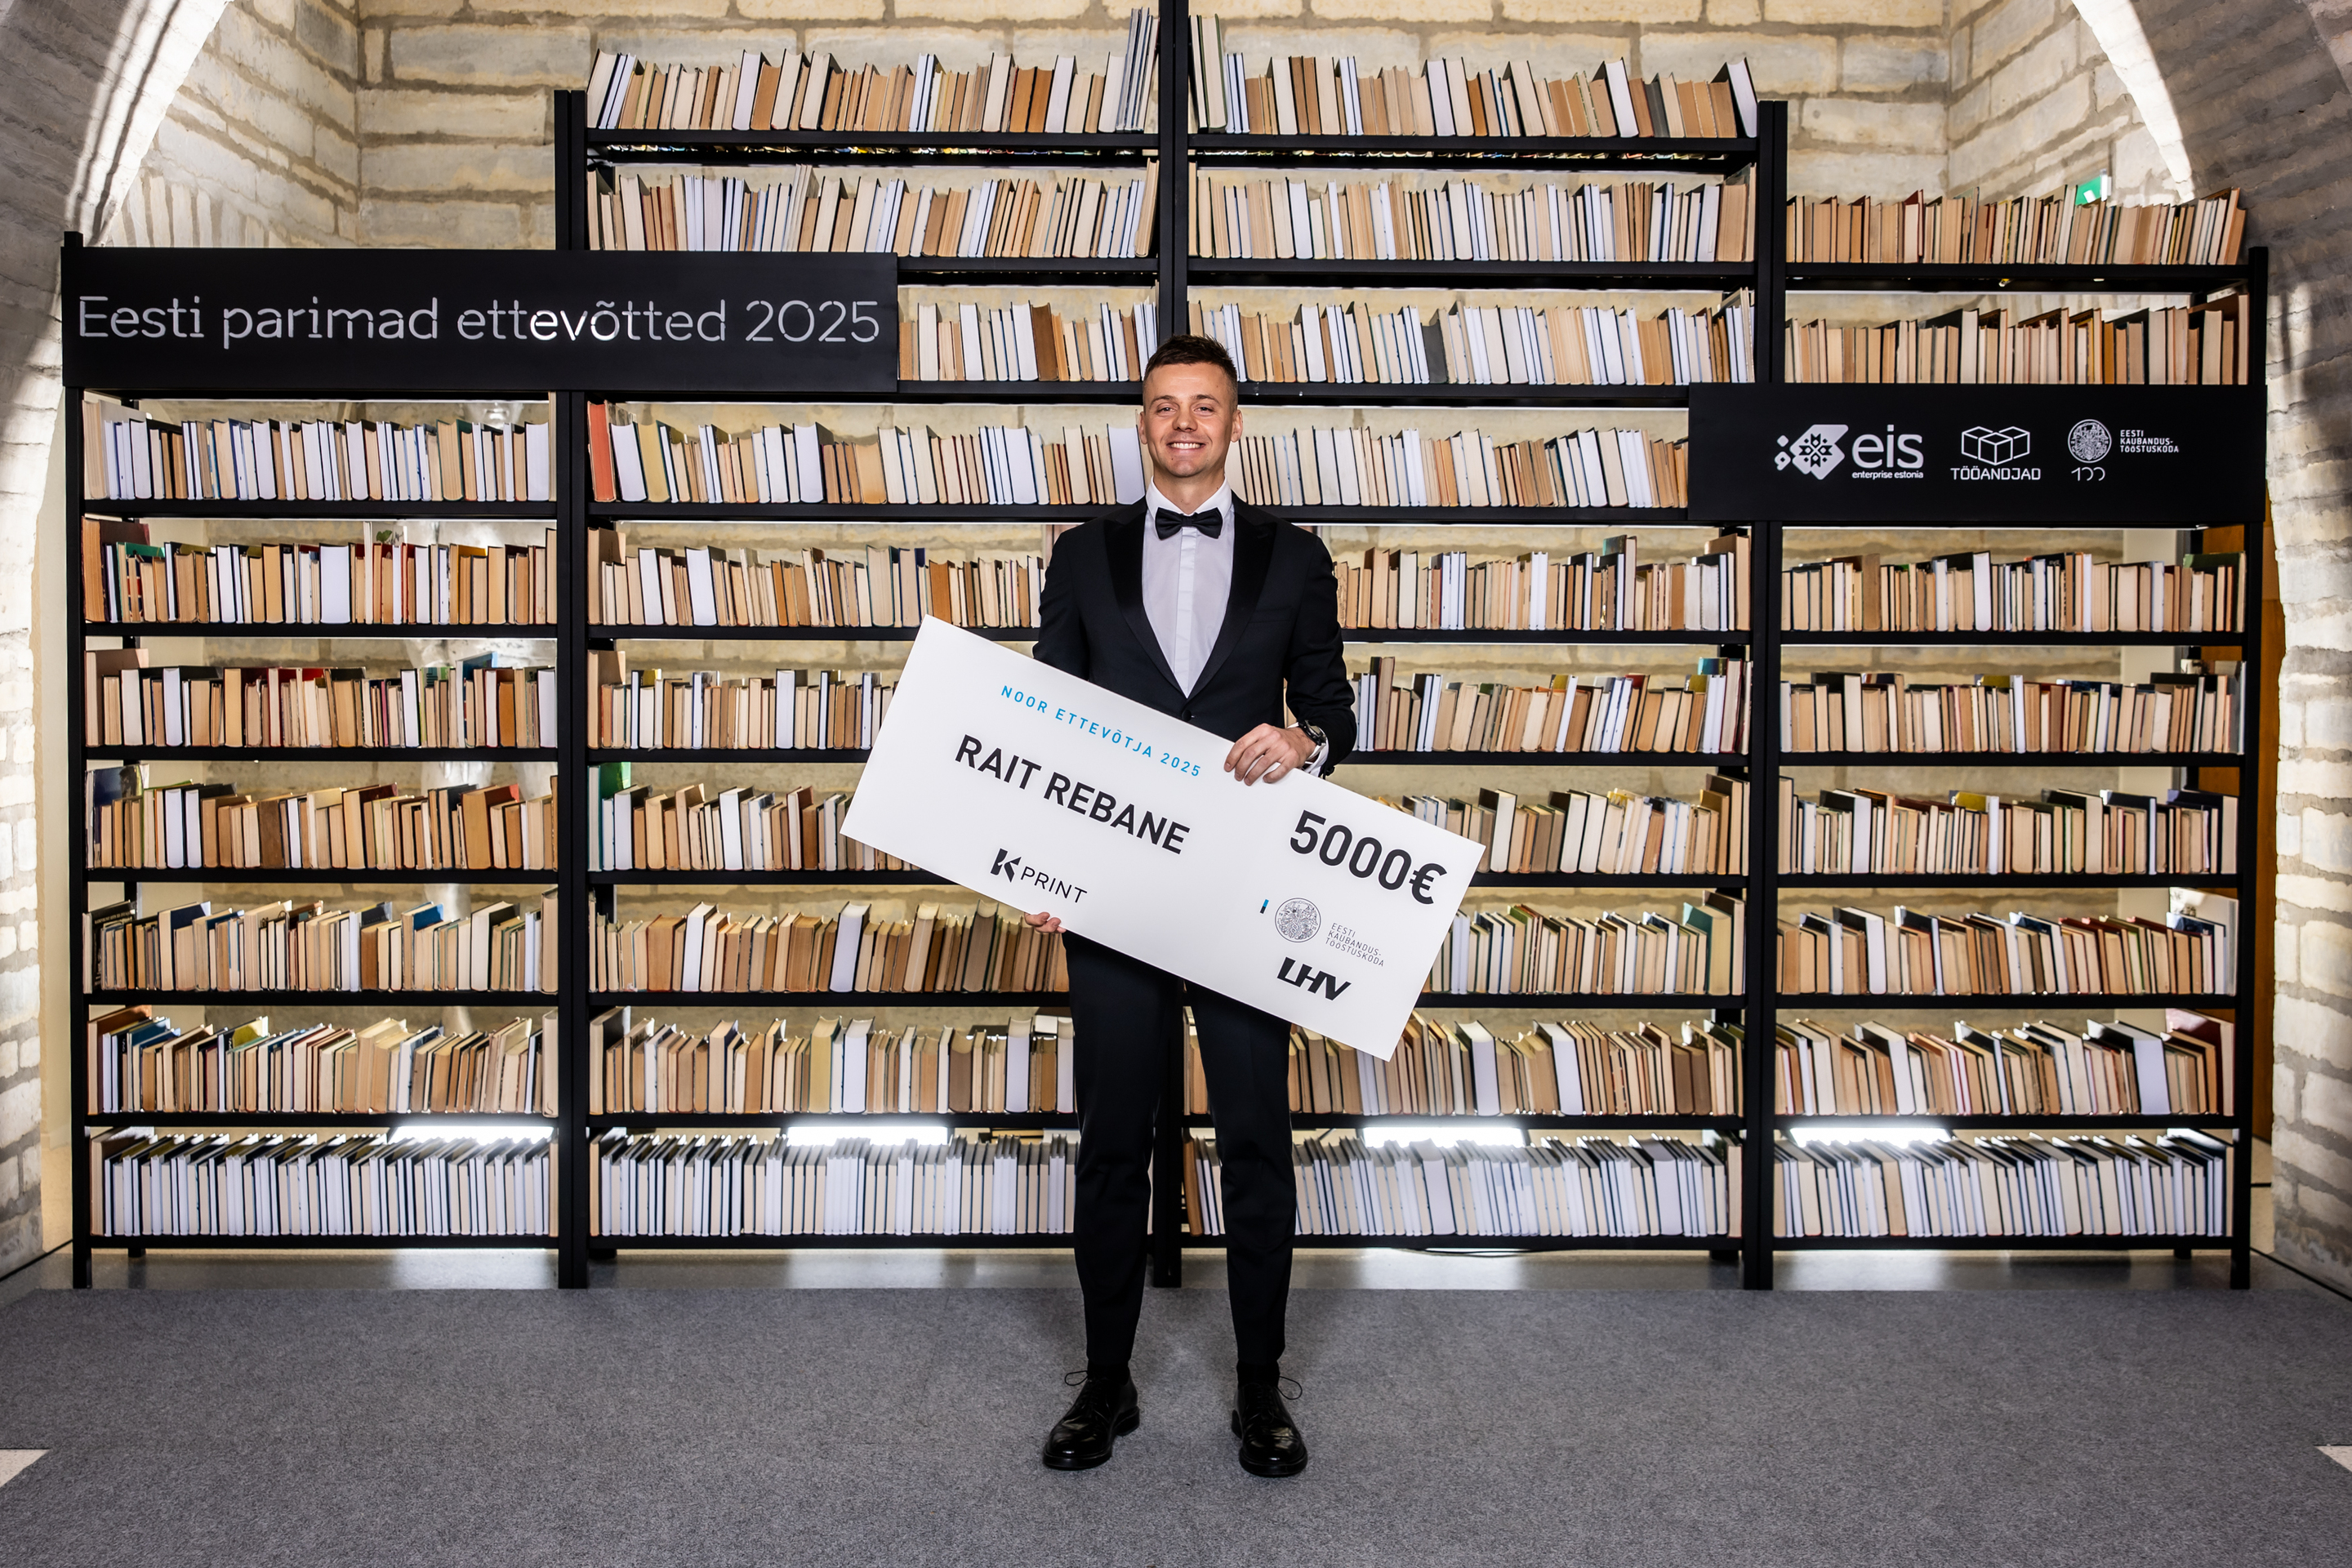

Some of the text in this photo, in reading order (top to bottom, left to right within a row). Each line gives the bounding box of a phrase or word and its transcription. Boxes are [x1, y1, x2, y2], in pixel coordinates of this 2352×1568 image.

[79, 296, 880, 350] Eesti parimad ettevõtted 2025
[1852, 424, 1924, 468] eis
[1851, 470, 1924, 480] enterprise estonia
[1949, 466, 2042, 480] TÖÖANDJAD
[1000, 685, 1200, 777] NOOR ETTEVÕTJA 2025
[955, 733, 1191, 855] RAIT REBANE
[1290, 809, 1448, 905] 5000€
[1328, 929, 1382, 956] KAUBANDUS-
[1331, 922, 1356, 938] EESTI
[1276, 956, 1352, 1001] LHV
